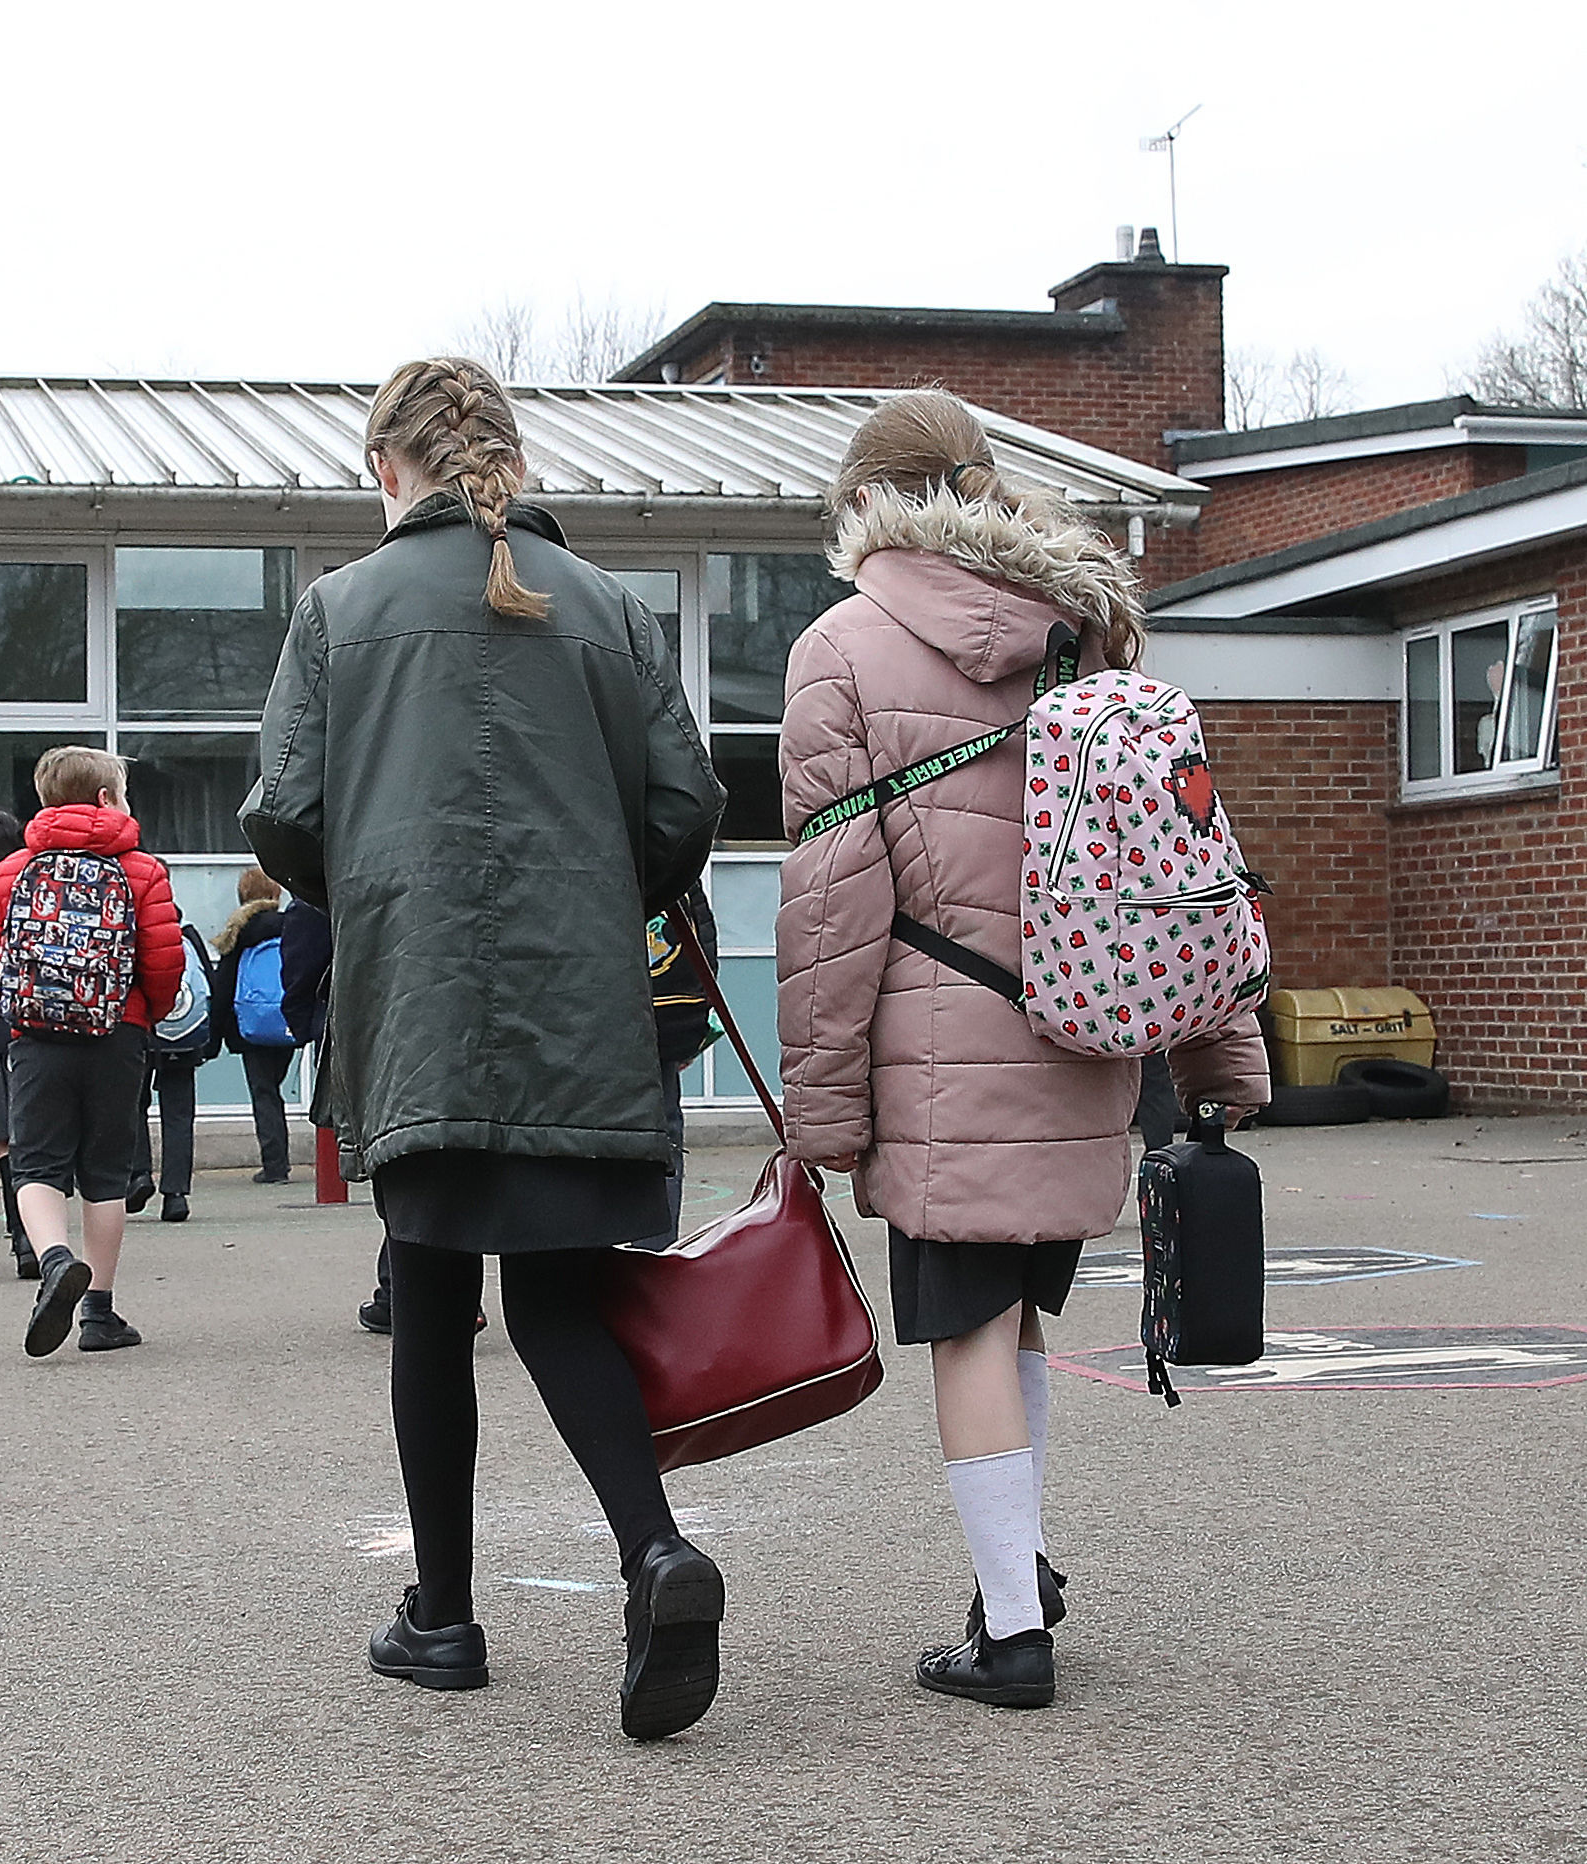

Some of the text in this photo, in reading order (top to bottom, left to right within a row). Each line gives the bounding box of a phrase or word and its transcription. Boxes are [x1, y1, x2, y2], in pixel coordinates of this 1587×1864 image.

[800, 729, 1008, 843] MINECRAFT MINECR
[1330, 1023, 1358, 1035] SALT
[1376, 1022, 1404, 1033] GRIT
